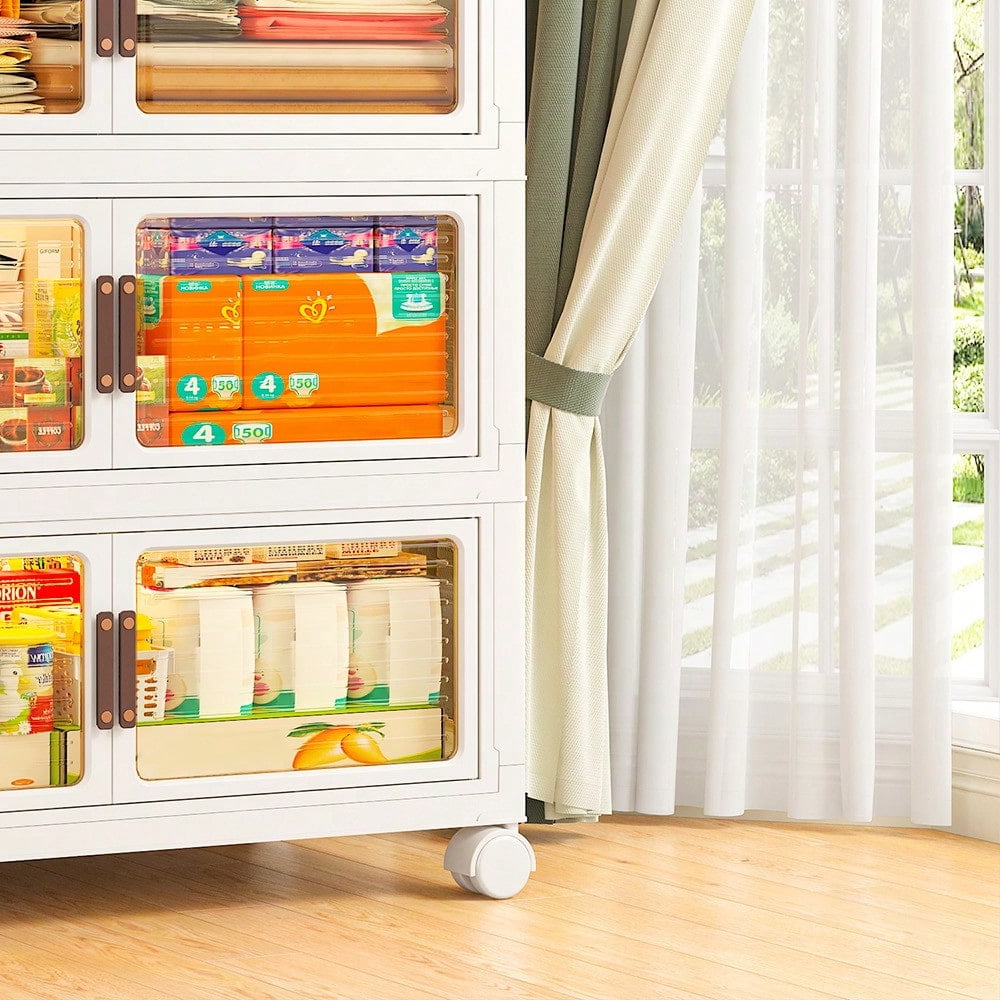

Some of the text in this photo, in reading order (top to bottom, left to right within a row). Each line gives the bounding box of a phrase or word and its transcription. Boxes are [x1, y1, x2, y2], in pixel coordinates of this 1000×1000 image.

[184, 377, 200, 395] 4
[217, 380, 234, 390] 50
[259, 375, 276, 392] 4
[295, 378, 312, 388] 50
[192, 424, 215, 442] 4
[242, 428, 264, 438] 50
